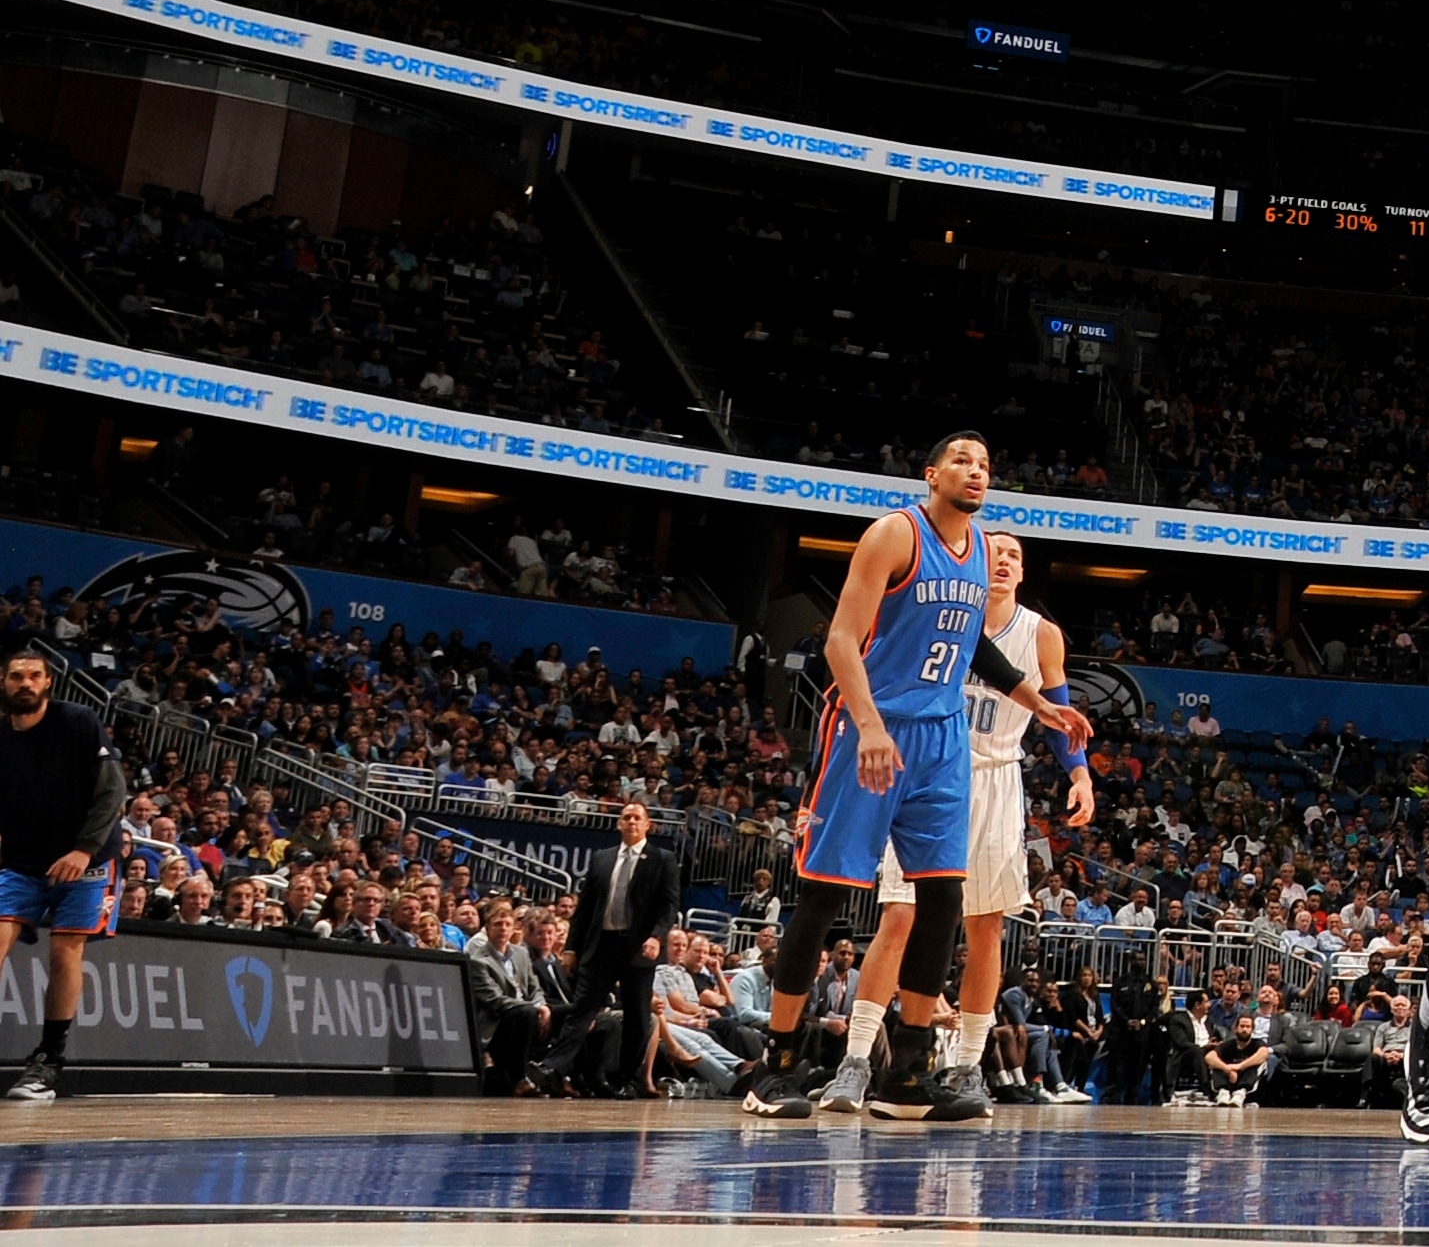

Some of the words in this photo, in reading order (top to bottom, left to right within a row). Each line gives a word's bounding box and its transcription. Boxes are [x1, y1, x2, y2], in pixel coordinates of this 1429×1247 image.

[326, 39, 358, 61] BE
[992, 30, 1062, 54] FANDUEL
[520, 82, 550, 104] BE
[707, 118, 735, 139] BE
[886, 151, 913, 171] BE
[1062, 176, 1089, 195] BE
[1269, 194, 1295, 207] 3-PT
[1297, 197, 1329, 209] FIELD
[1331, 200, 1367, 213] GOALS
[1264, 206, 1311, 226] 6-20
[1334, 213, 1378, 232] 30%
[1409, 220, 1426, 236] 11
[1062, 323, 1107, 337] FDUEL
[39, 347, 80, 376] BE
[82, 356, 268, 411] SPORTSRICH
[288, 396, 328, 423] BE
[330, 403, 500, 454] SPORTSRICH
[502, 434, 536, 458] BE
[538, 440, 706, 483] SPORTSRICH
[723, 468, 758, 493] BE
[1155, 520, 1188, 542] BE
[1192, 523, 1344, 555] SPORTSRICH
[1363, 538, 1397, 559] BE
[348, 601, 386, 622] 108
[936, 608, 971, 634] CITY
[917, 640, 961, 685] 21
[1176, 691, 1211, 708] 109
[285, 975, 460, 1042] FANDUEL
